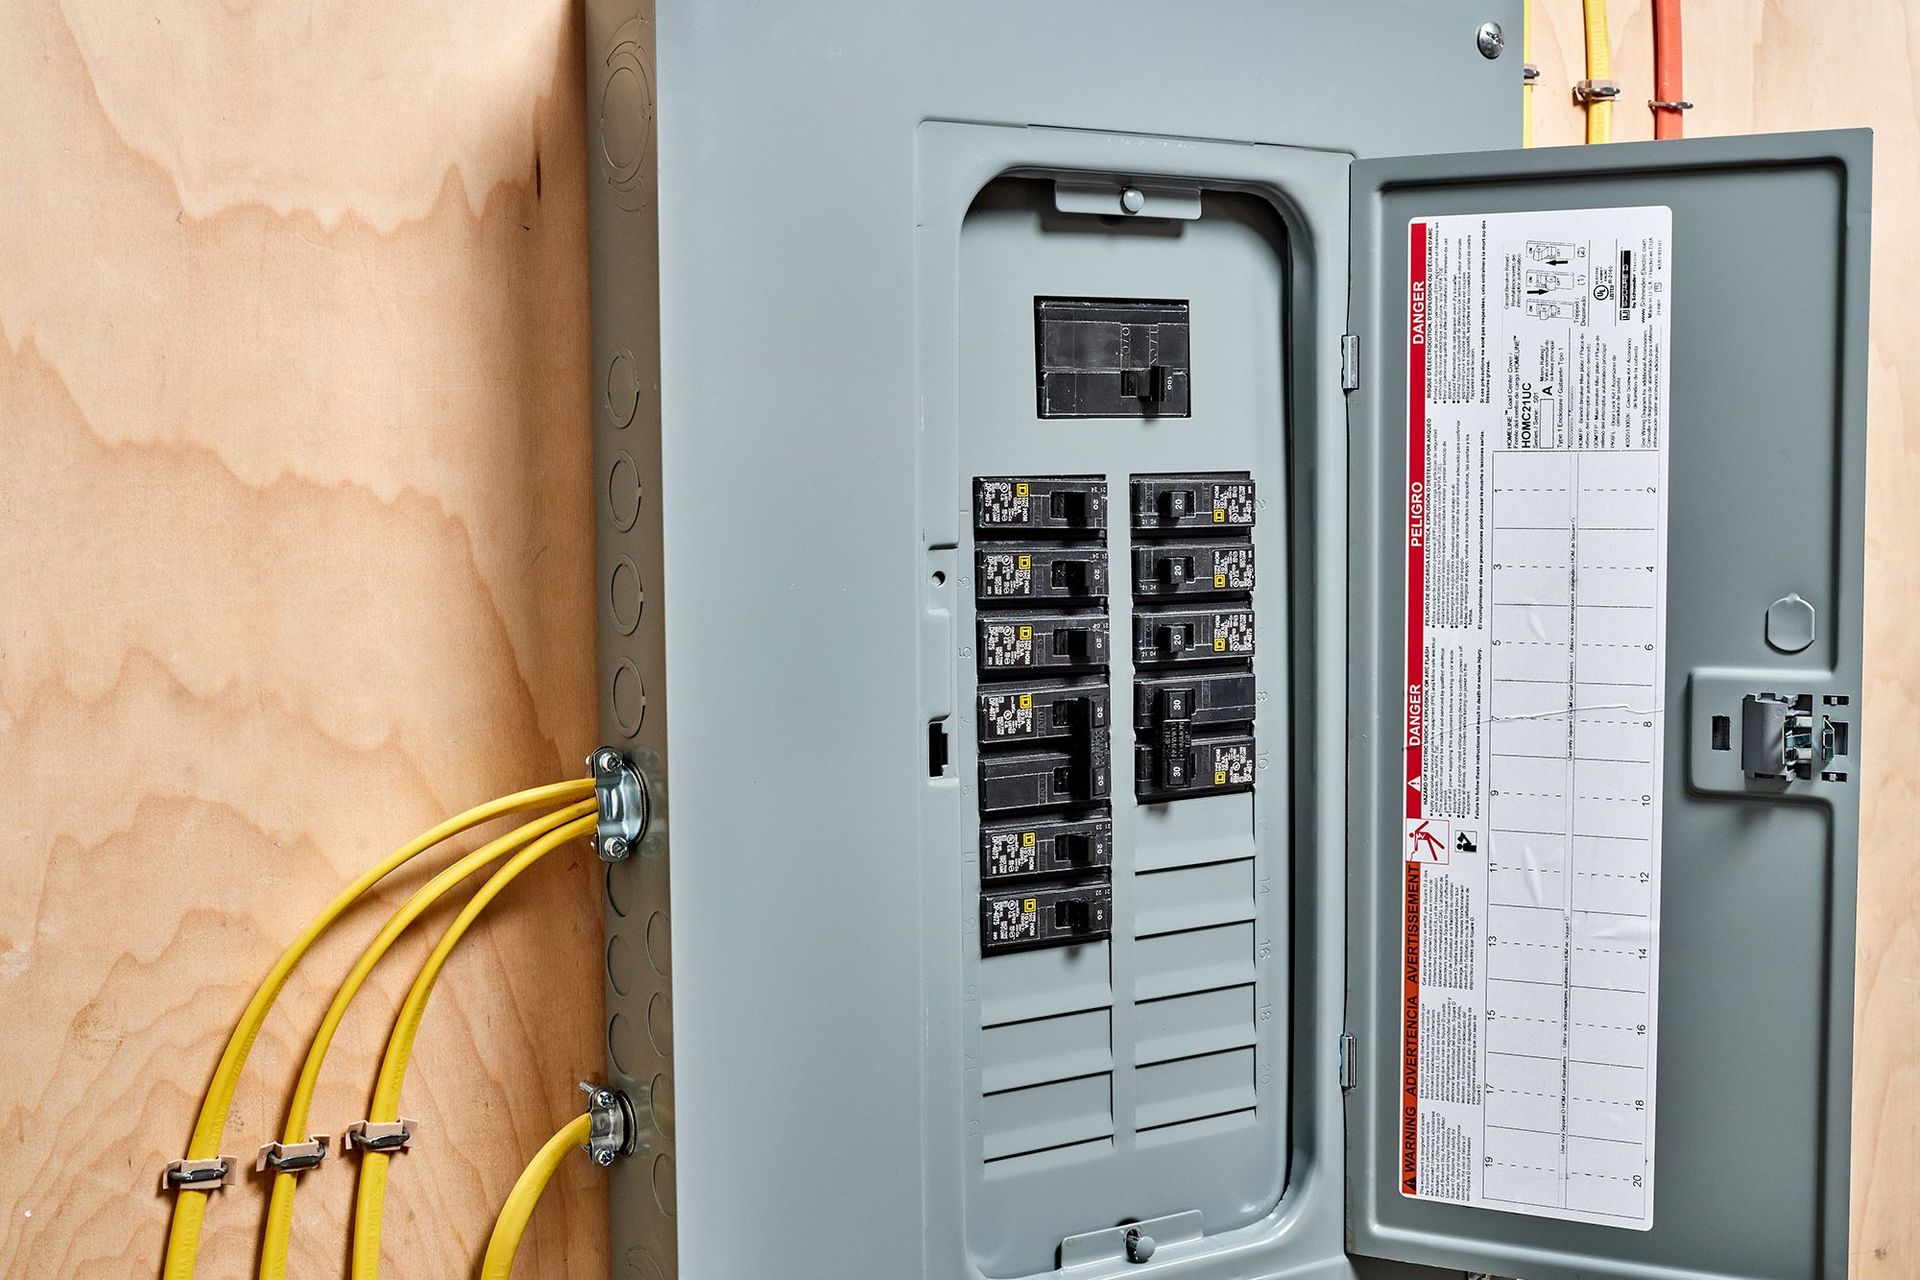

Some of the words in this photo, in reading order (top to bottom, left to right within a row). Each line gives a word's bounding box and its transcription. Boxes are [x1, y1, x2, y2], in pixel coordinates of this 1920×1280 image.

[1577, 246, 1585, 257] (2)
[1427, 273, 1432, 282] OU
[1577, 274, 1585, 285] (1)
[1412, 281, 1424, 343] DANGER
[1542, 385, 1552, 396] A
[1521, 382, 1531, 448] HOMC21UC
[1093, 499, 1098, 509] 20
[1175, 499, 1182, 509] 20
[1411, 482, 1422, 546] PELIGRO
[1095, 568, 1101, 579] 20
[1174, 566, 1181, 575] 20
[1425, 592, 1430, 600] DE
[1096, 638, 1102, 648] 20
[1174, 635, 1181, 645] 20
[1424, 679, 1429, 687] OR
[1174, 700, 1181, 710] 30
[1097, 707, 1103, 718] 20
[1409, 684, 1420, 745] DANGER
[1173, 767, 1180, 777] 30
[1423, 773, 1428, 781] OF
[1098, 775, 1103, 786] 20
[1641, 792, 1650, 807] 10
[1097, 844, 1102, 854] 20
[1489, 861, 1497, 873] 11
[1639, 871, 1649, 883] 12
[1097, 910, 1102, 920] 20
[1407, 864, 1418, 983] AVERTISSEMENT
[1488, 935, 1496, 947] 13
[1638, 948, 1646, 959] 14
[1487, 1009, 1495, 1022] 15
[1636, 1023, 1645, 1035] 16
[1406, 995, 1417, 1096] ADVERTENCIA
[1485, 1083, 1494, 1095] 17
[1634, 1097, 1644, 1111] 18
[1405, 1106, 1415, 1171] WARNING
[1484, 1156, 1493, 1167] 19
[1632, 1174, 1642, 1187] 20
